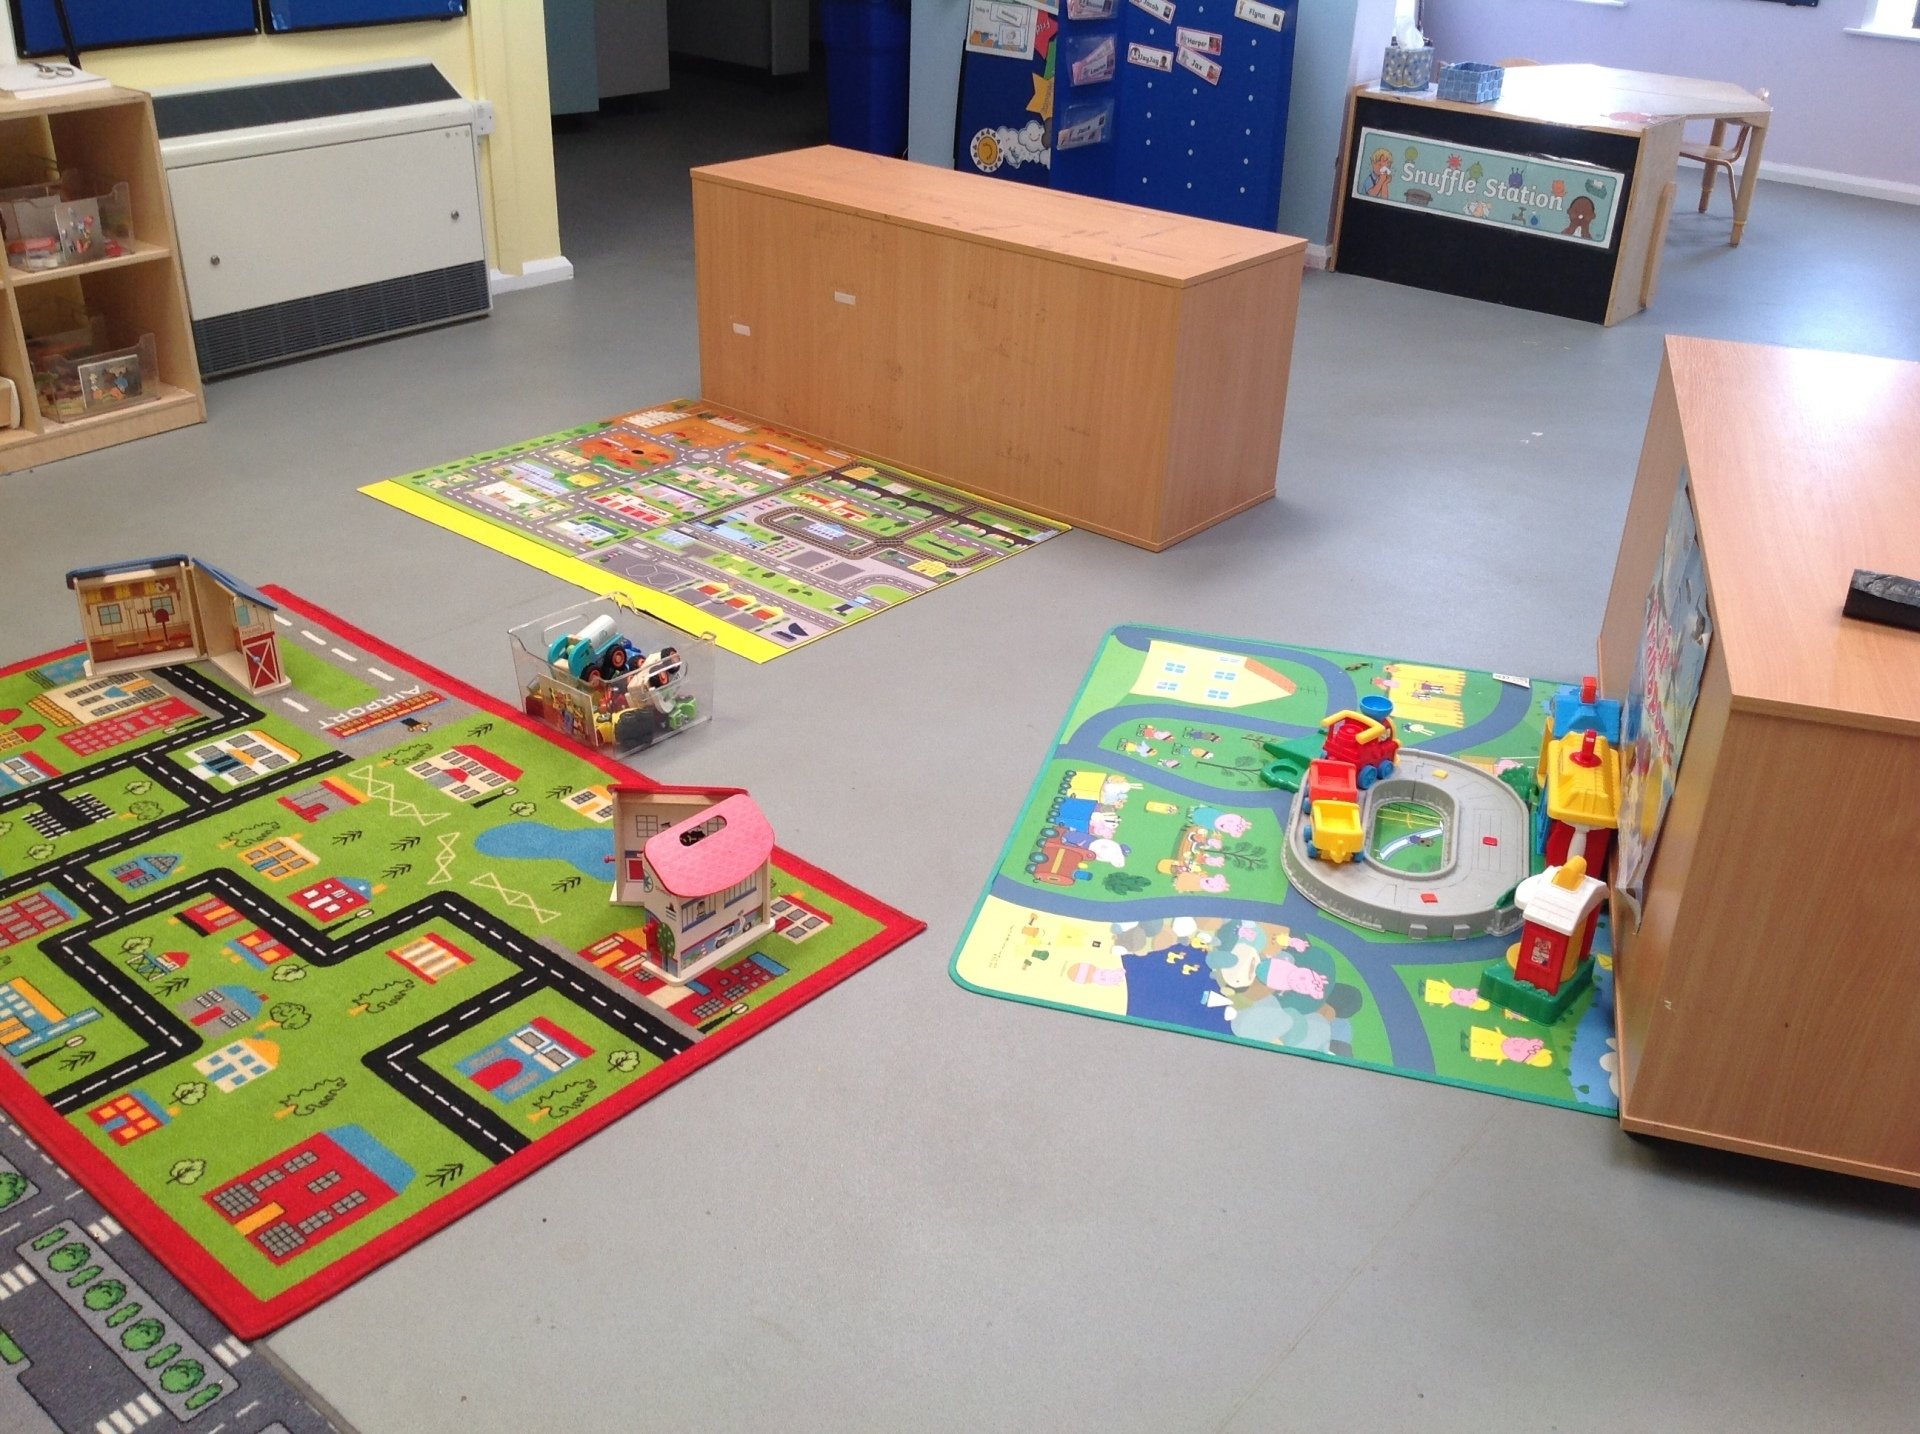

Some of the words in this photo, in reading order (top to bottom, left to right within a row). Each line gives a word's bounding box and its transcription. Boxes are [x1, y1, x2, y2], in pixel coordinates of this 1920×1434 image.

[1248, 8, 1266, 20] Flynn
[1187, 37, 1207, 48] Harper
[1140, 53, 1160, 66] JayJay
[1191, 59, 1203, 71] Jax
[1401, 162, 1477, 195] Snuffle
[1483, 178, 1563, 212] Station
[319, 684, 421, 730] AIRPORT
